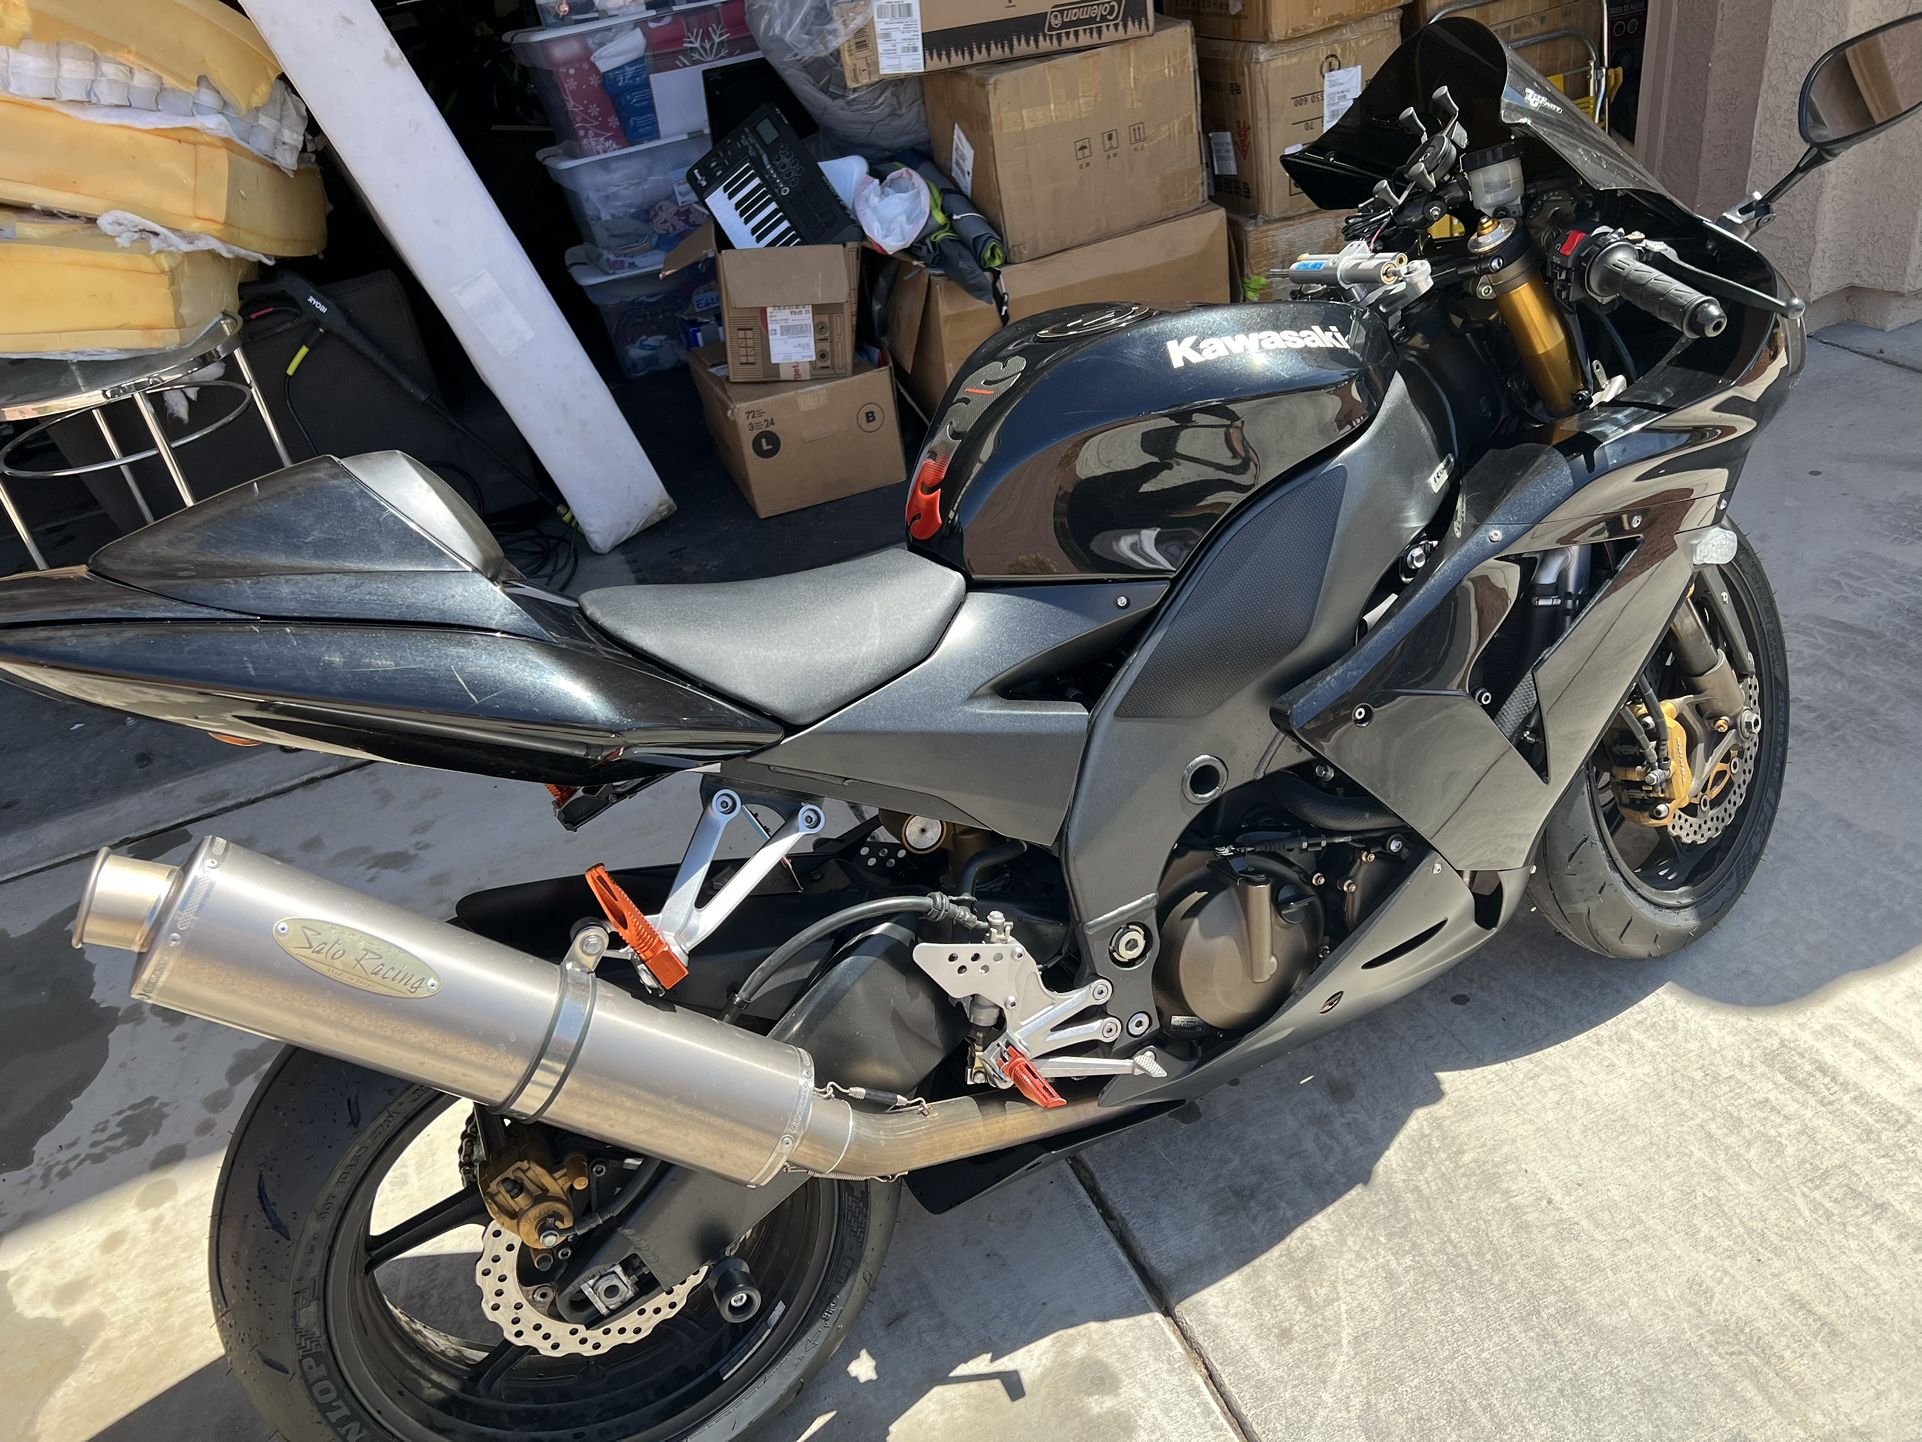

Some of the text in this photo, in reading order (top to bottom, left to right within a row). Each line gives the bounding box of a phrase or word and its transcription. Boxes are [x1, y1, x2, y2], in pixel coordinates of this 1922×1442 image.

[1063, 1, 1118, 22] Coleman
[1294, 97, 1308, 108] 600
[307, 295, 328, 314] RYOBI
[1166, 325, 1351, 368] Kawasaki
[745, 411, 756, 420] 72
[865, 411, 876, 423] B
[748, 423, 755, 431] 3
[763, 418, 775, 428] 24
[761, 438, 773, 450] L
[288, 925, 346, 960] Sato
[352, 948, 426, 994] Racing
